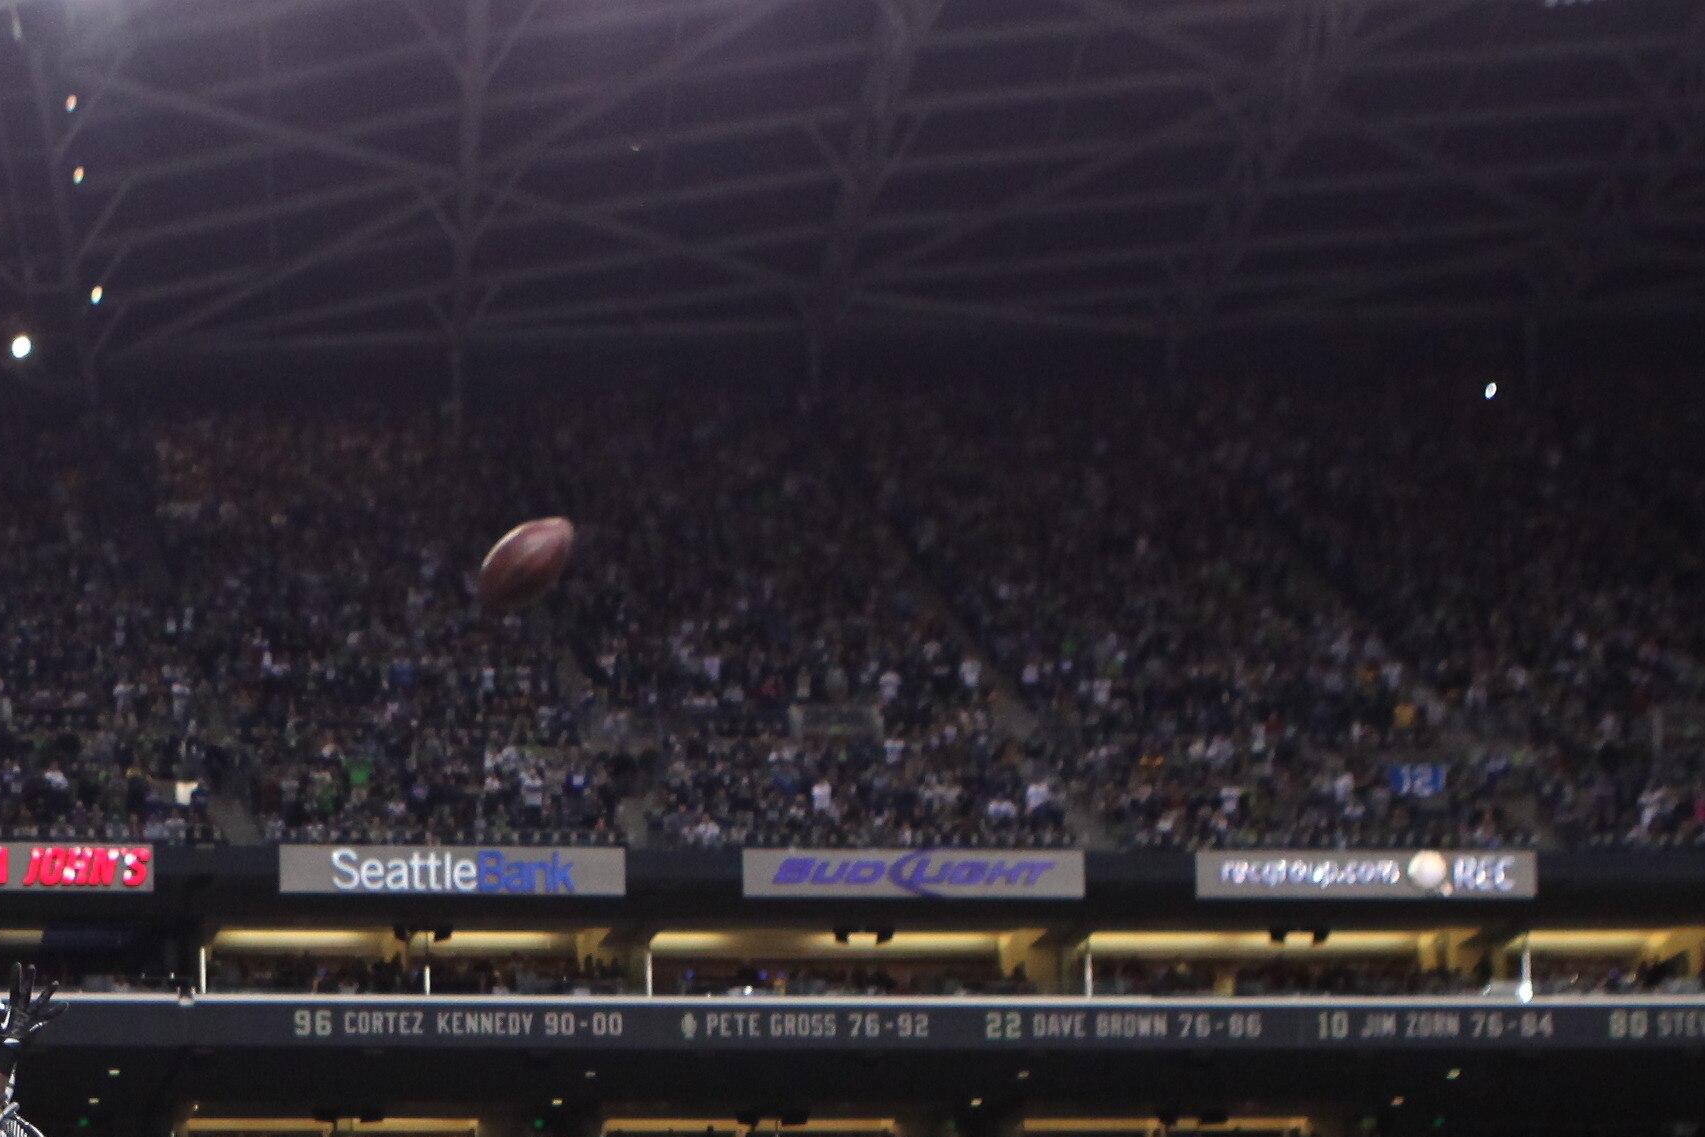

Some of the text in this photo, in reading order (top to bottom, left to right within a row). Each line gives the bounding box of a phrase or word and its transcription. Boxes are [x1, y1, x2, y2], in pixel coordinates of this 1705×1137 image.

[23, 845, 151, 887] JOHN'S
[331, 848, 576, 892] SeattleBank
[772, 857, 1056, 886] BUD LIGHT
[294, 1010, 624, 1037] 96 CORTEZ KENNEDY 90-00
[705, 1012, 930, 1039] PETE GROSS 76-92
[985, 1011, 1023, 1040] 22
[1032, 1013, 1087, 1039] DAVE
[1096, 1013, 1168, 1039] BROWN
[1317, 1011, 1348, 1040] 10
[1360, 1012, 1398, 1039] JIM
